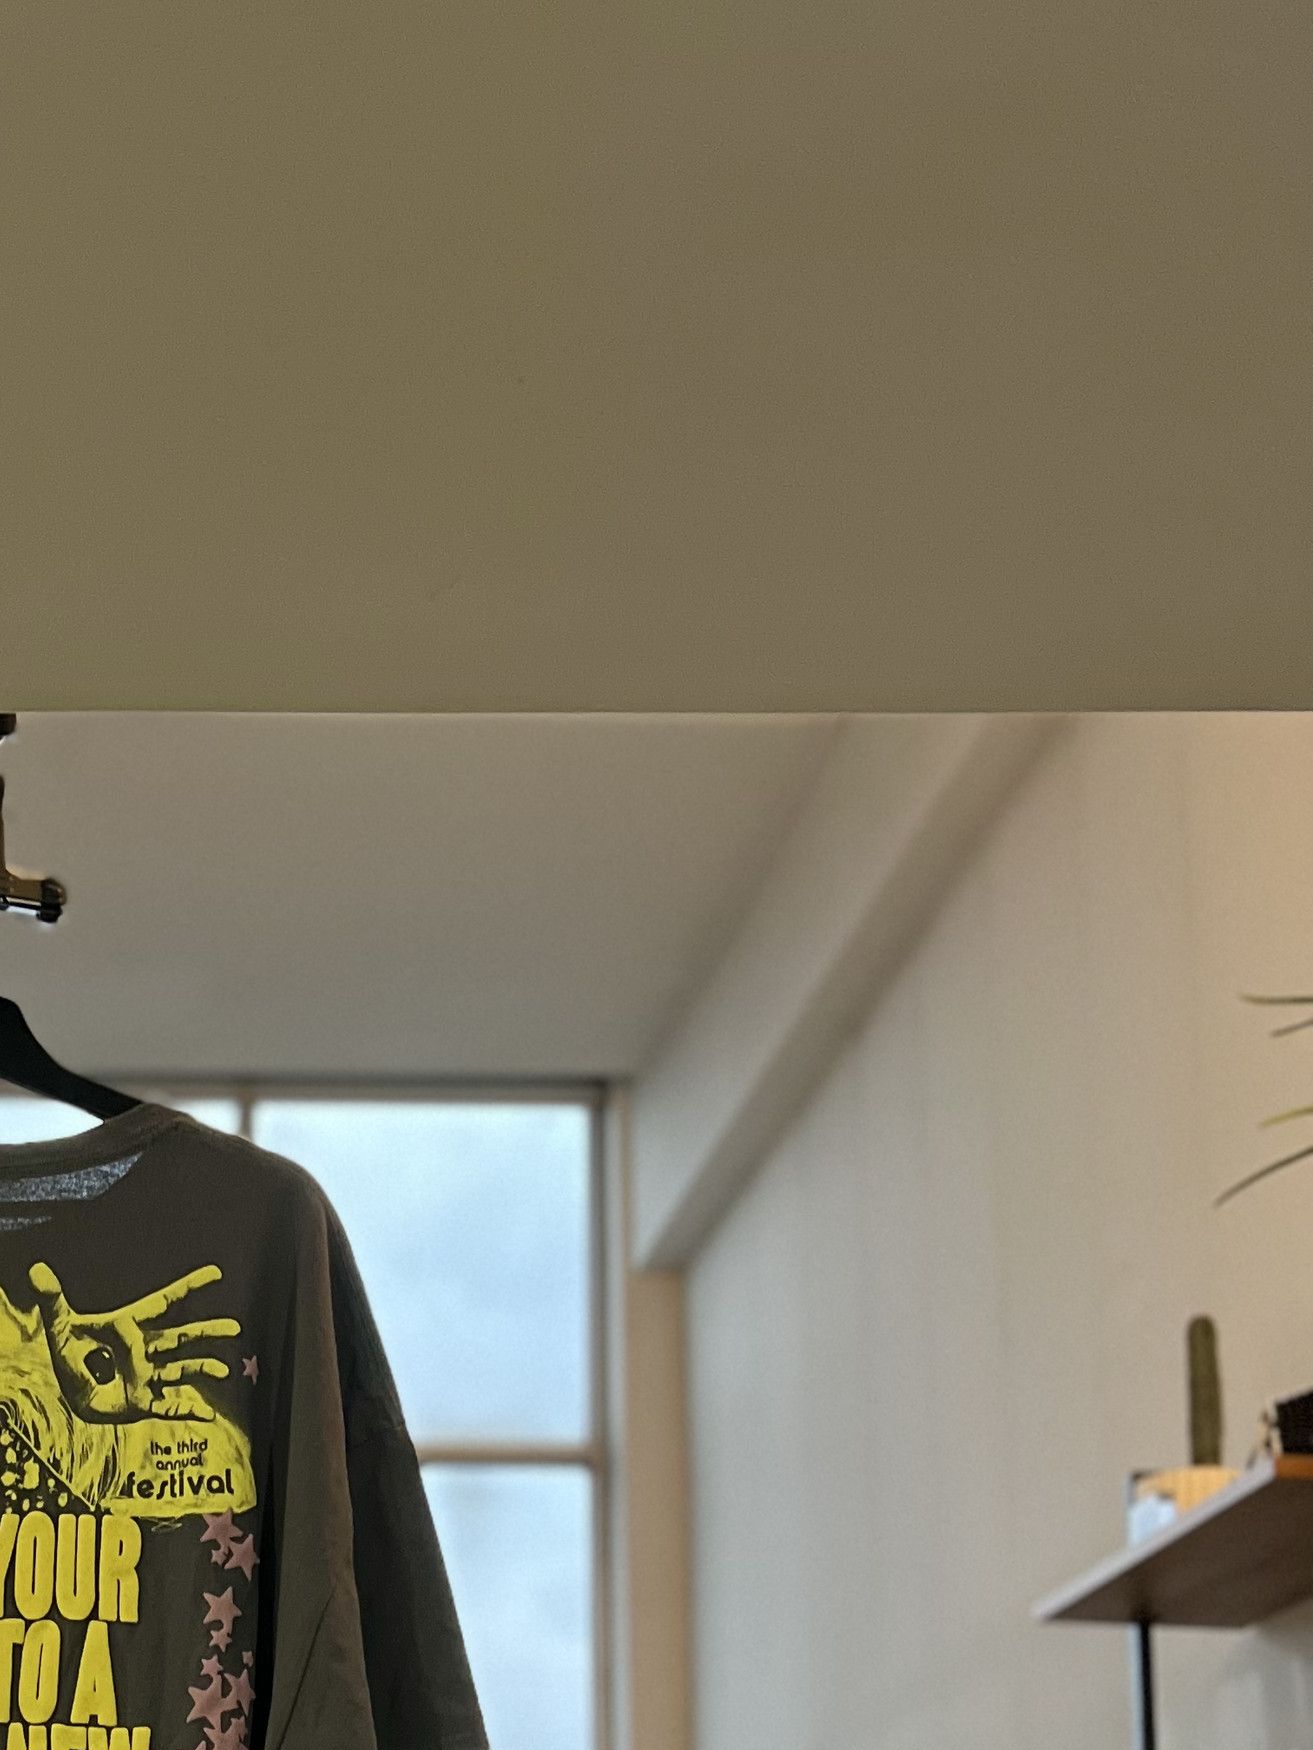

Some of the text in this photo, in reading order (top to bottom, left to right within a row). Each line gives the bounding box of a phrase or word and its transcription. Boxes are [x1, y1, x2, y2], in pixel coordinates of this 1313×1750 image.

[150, 1438, 208, 1455] the third
[156, 1453, 204, 1470] annual
[126, 1468, 234, 1500] festival
[70, 1620, 118, 1727] A
